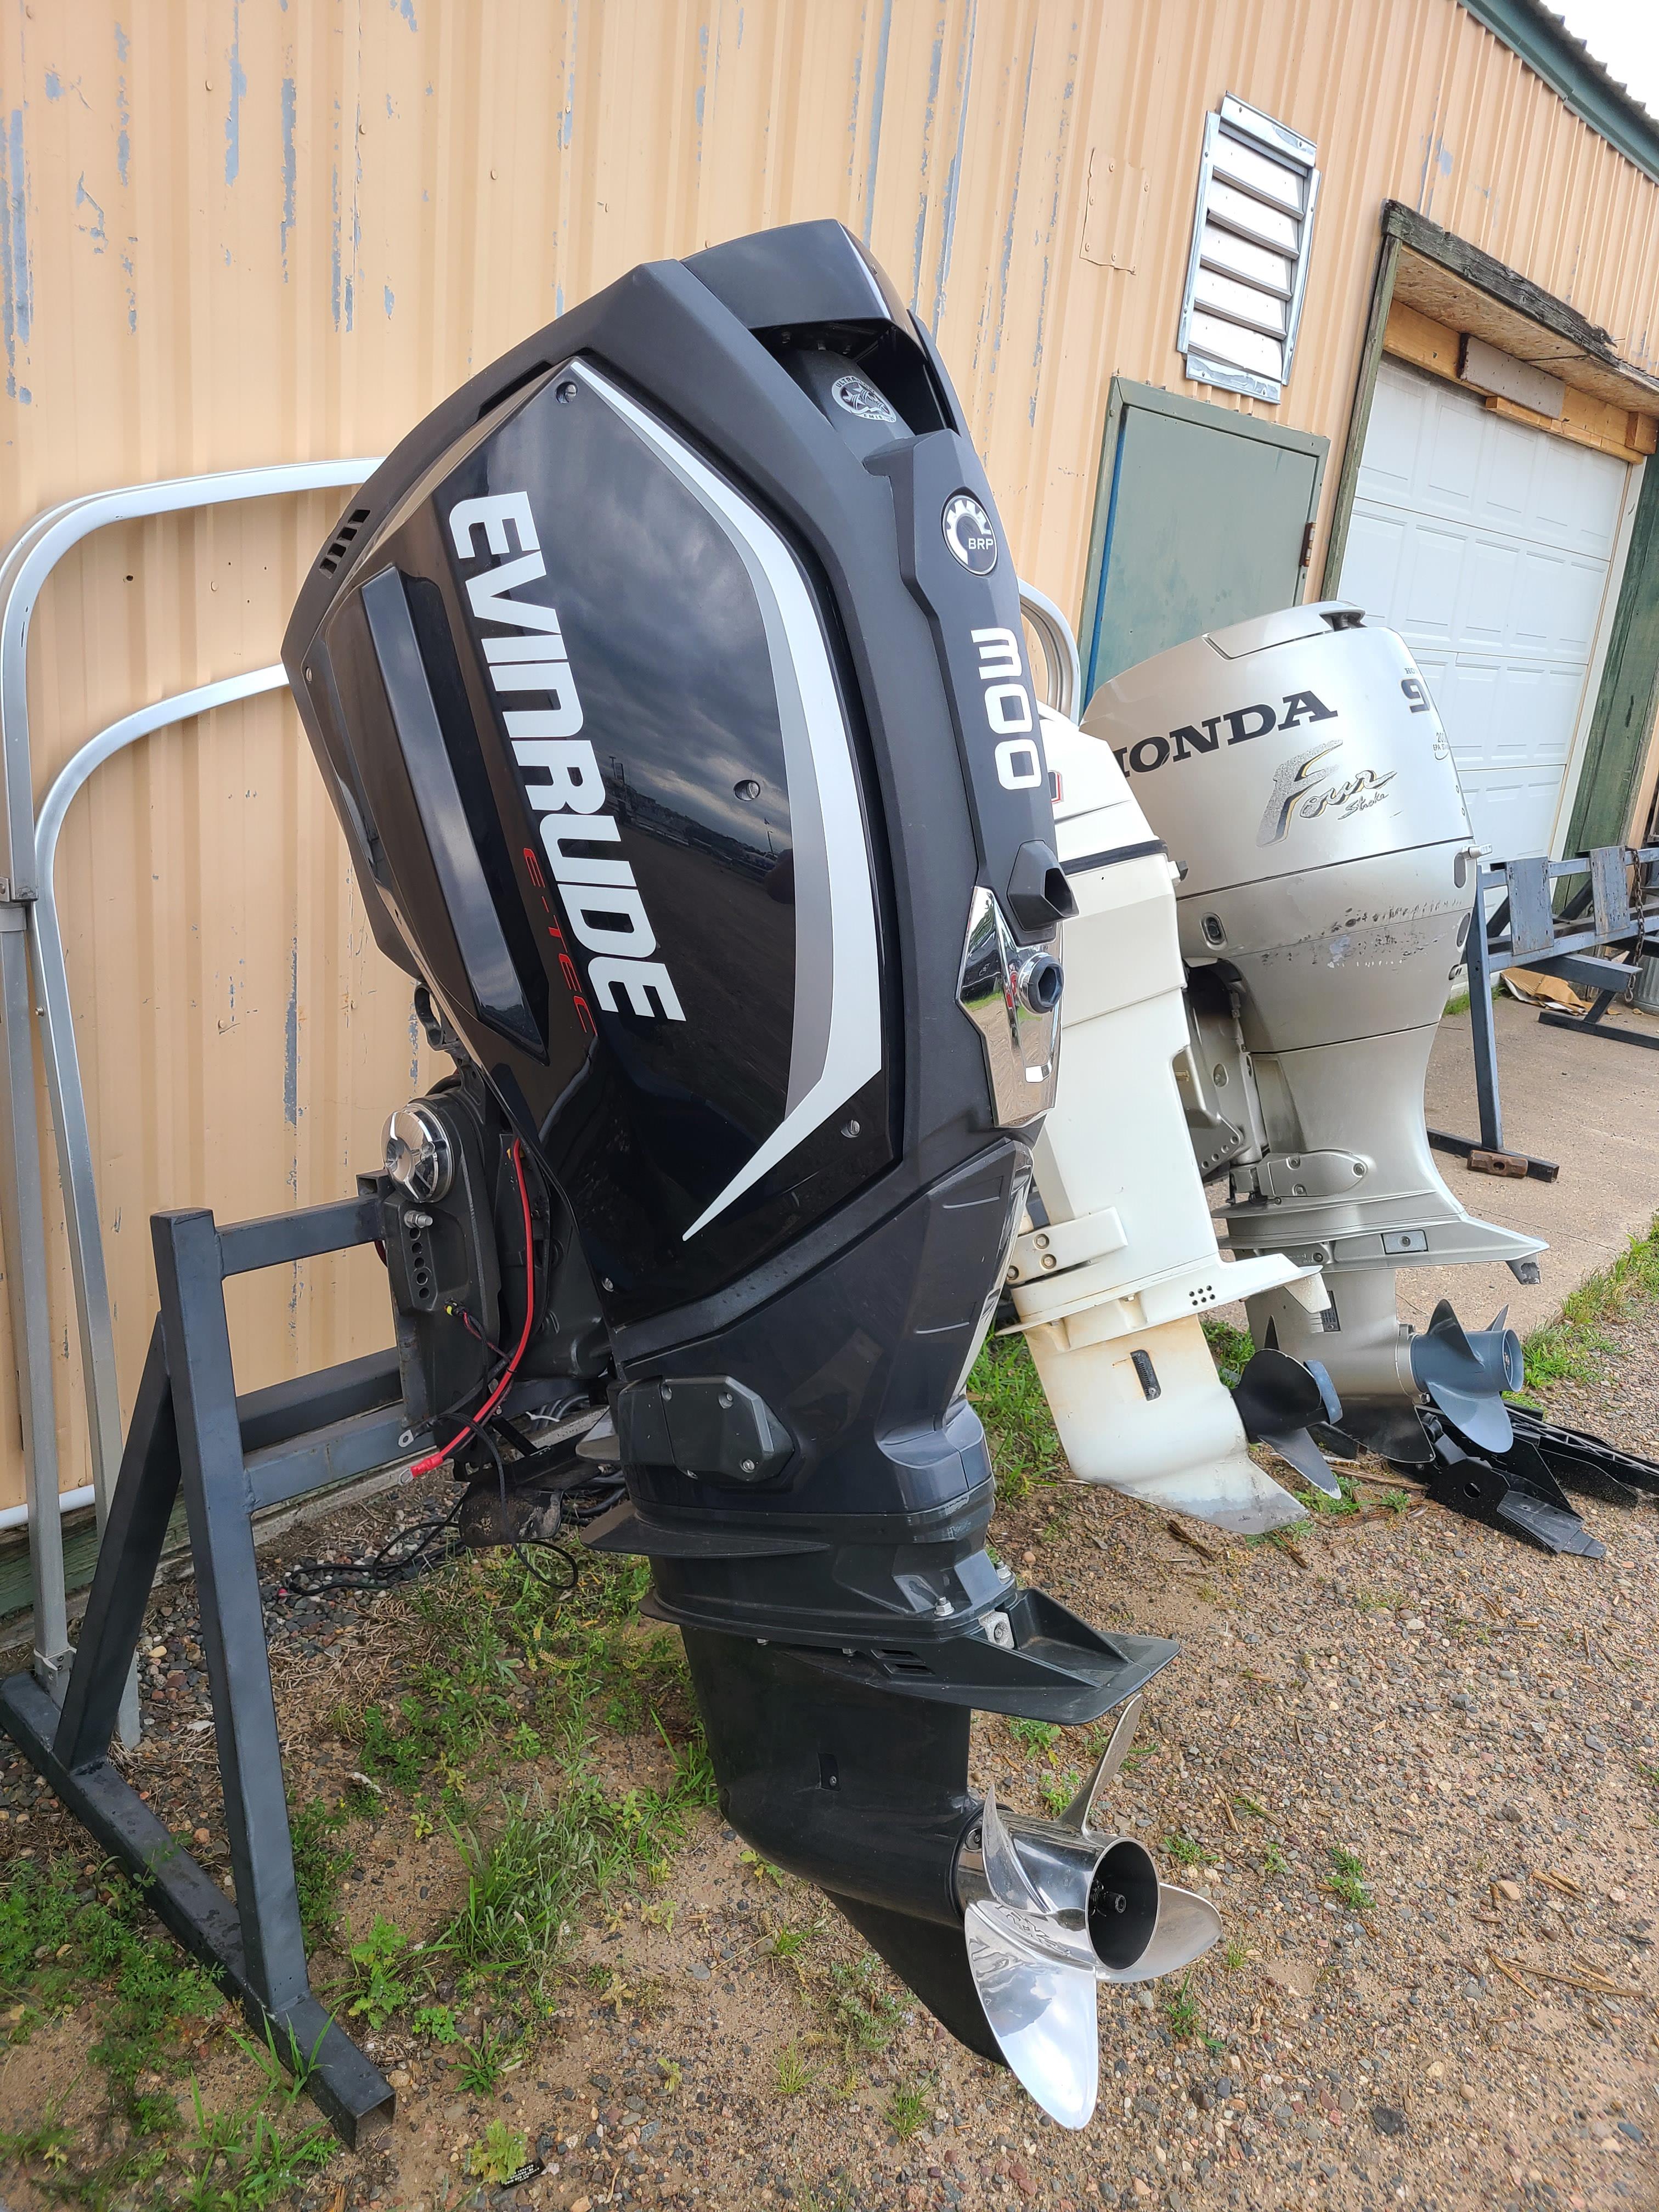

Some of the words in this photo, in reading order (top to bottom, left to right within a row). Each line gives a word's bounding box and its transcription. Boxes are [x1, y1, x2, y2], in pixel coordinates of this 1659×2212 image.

[968, 538, 994, 550] BRP
[449, 491, 686, 1022] EVINRUDE
[970, 628, 1042, 790] 300
[1256, 739, 1398, 848] Four
[523, 848, 598, 1036] E-TEC
